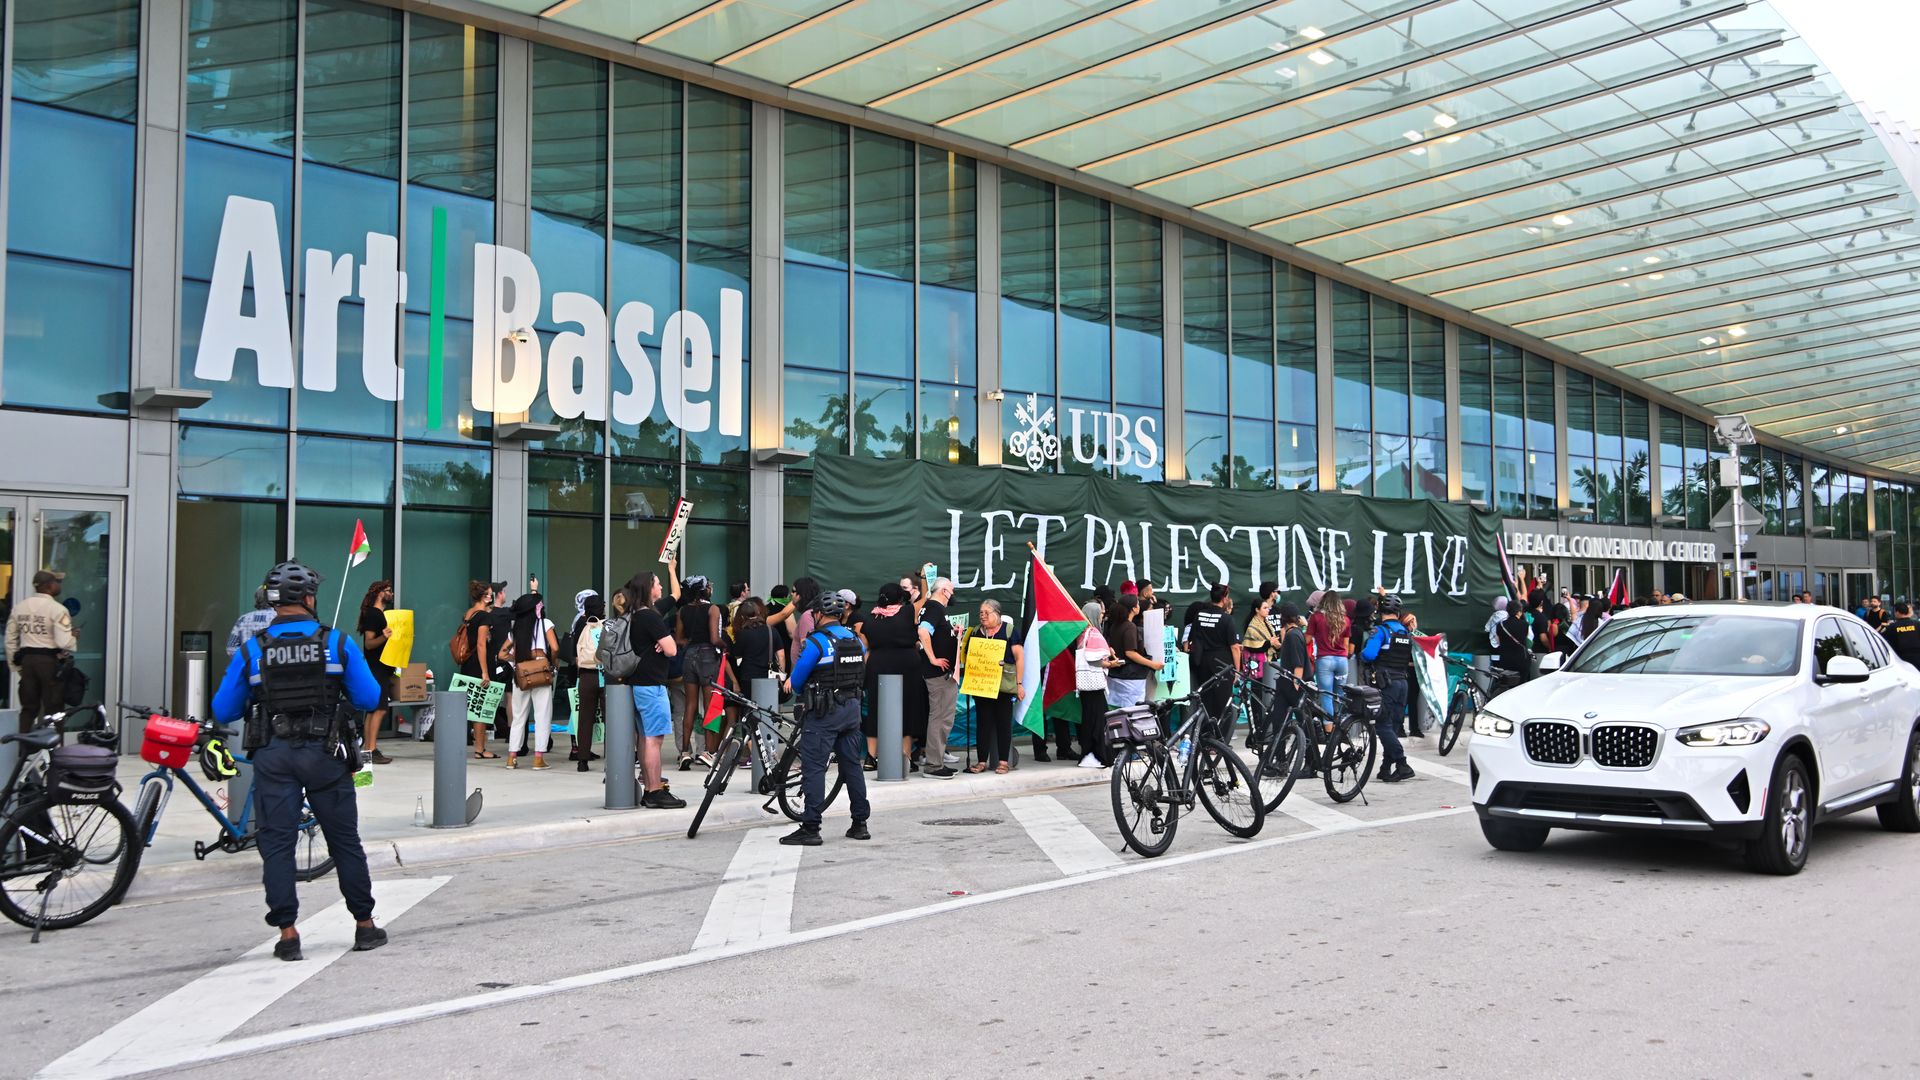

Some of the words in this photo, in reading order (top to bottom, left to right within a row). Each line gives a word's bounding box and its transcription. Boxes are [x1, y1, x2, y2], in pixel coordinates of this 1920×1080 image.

[194, 195, 408, 401] Art
[471, 242, 743, 437] Basel
[1068, 407, 1158, 469] UBS
[946, 508, 1068, 592] LET
[1082, 513, 1353, 594] PALESTINE
[1371, 528, 1470, 596] LIVE
[1512, 531, 1568, 556] BEACH
[1570, 535, 1667, 561] CONVENTION
[1668, 541, 1717, 563] CENTER
[18, 623, 48, 635] POLICE
[1896, 625, 1916, 633] POLICE
[1395, 637, 1410, 645] POLICE
[266, 644, 321, 666] POLICE
[840, 655, 863, 664] POLICE
[469, 685, 482, 713] FROM
[1143, 728, 1157, 736] POLICE
